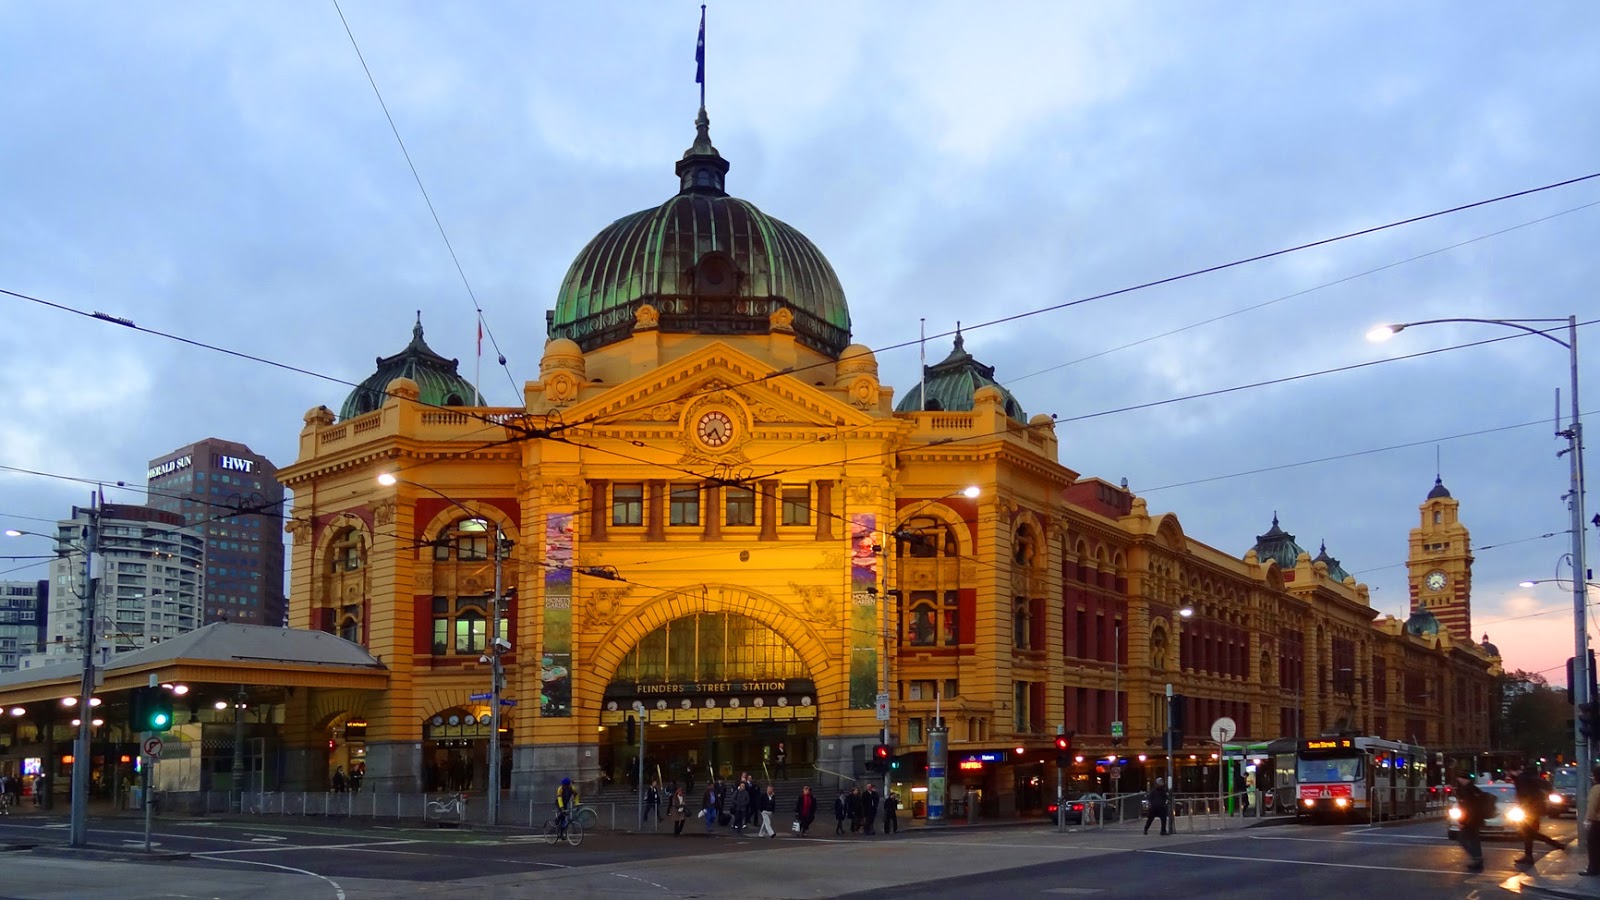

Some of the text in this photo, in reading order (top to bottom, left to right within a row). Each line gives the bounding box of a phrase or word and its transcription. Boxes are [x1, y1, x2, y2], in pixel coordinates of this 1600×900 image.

[147, 455, 192, 479] HERALD SUN
[222, 455, 254, 472] HWT
[637, 682, 786, 693] FLINDERS STREET STATION
